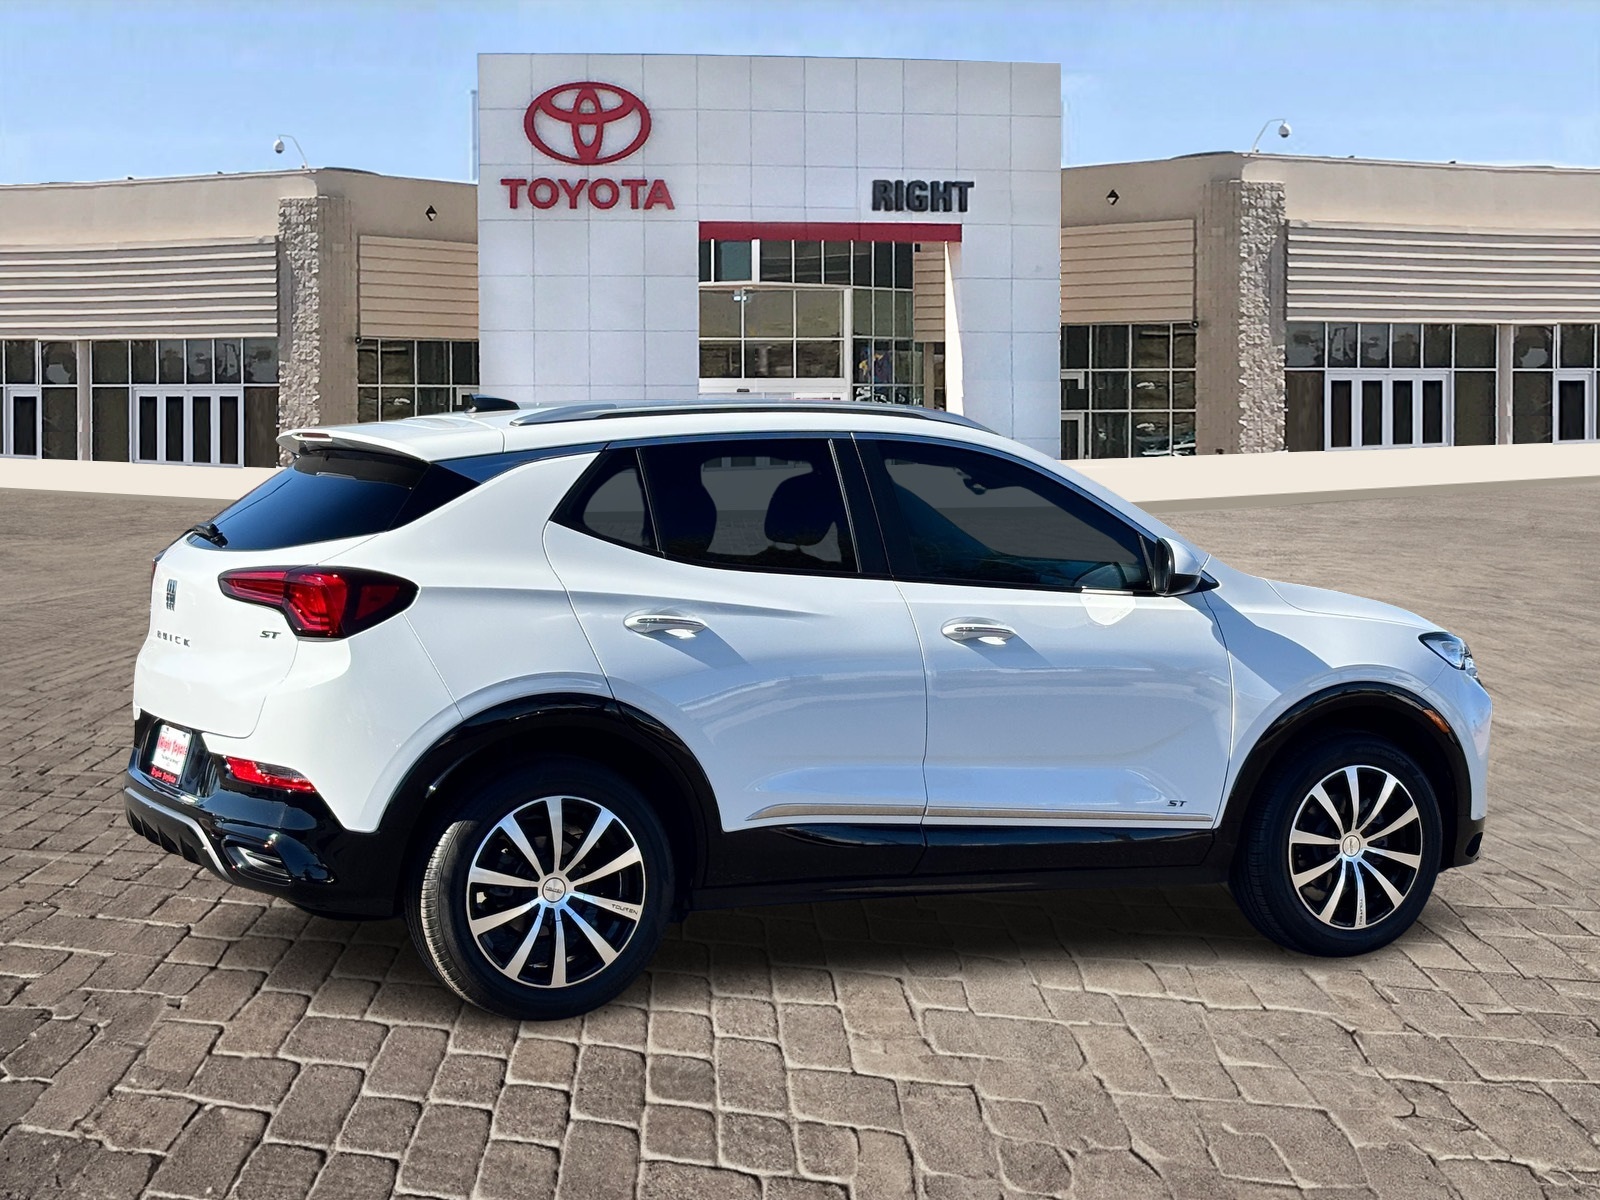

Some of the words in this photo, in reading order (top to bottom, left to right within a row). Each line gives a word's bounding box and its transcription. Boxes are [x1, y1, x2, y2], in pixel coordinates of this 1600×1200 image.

[500, 178, 675, 210] TOYOTA
[872, 180, 975, 212] RIGHT
[260, 630, 281, 639] ST
